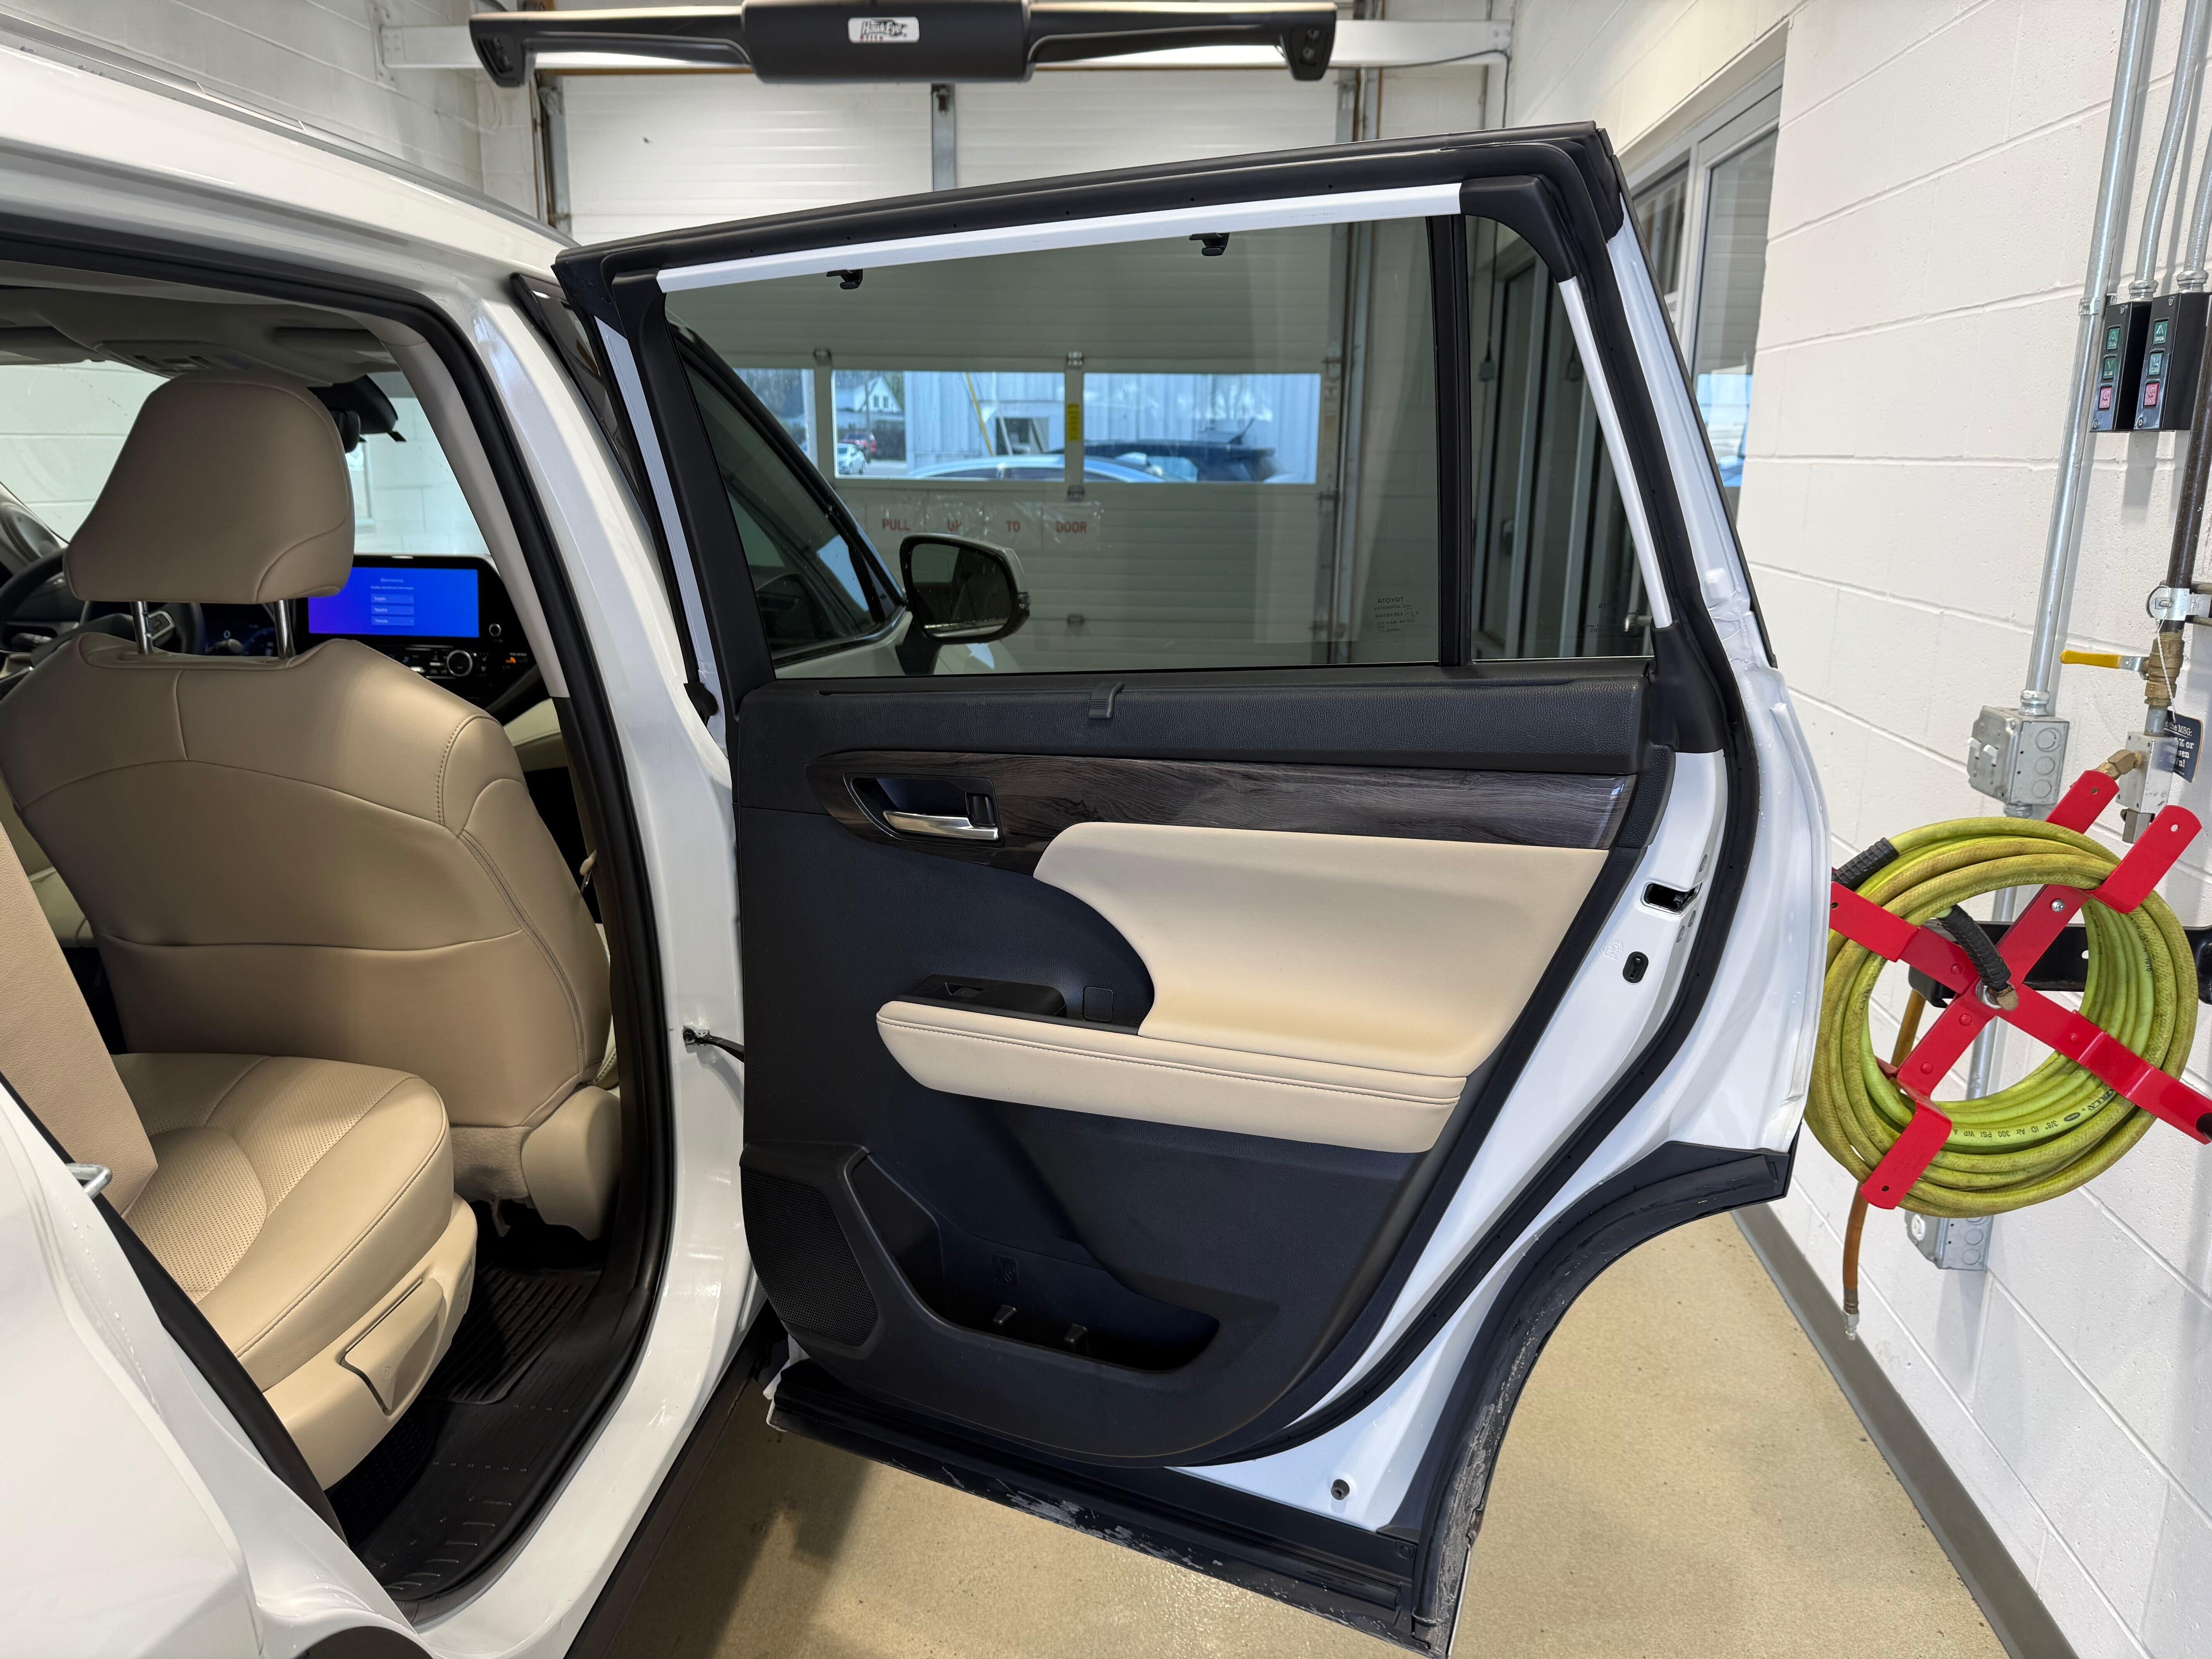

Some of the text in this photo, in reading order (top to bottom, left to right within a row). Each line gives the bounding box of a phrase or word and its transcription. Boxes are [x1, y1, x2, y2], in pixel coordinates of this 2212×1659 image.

[882, 518, 910, 531] PULL
[1006, 520, 1021, 532] TO
[1055, 521, 1087, 534] DOOR
[2045, 1120, 2058, 1130] 3/8"
